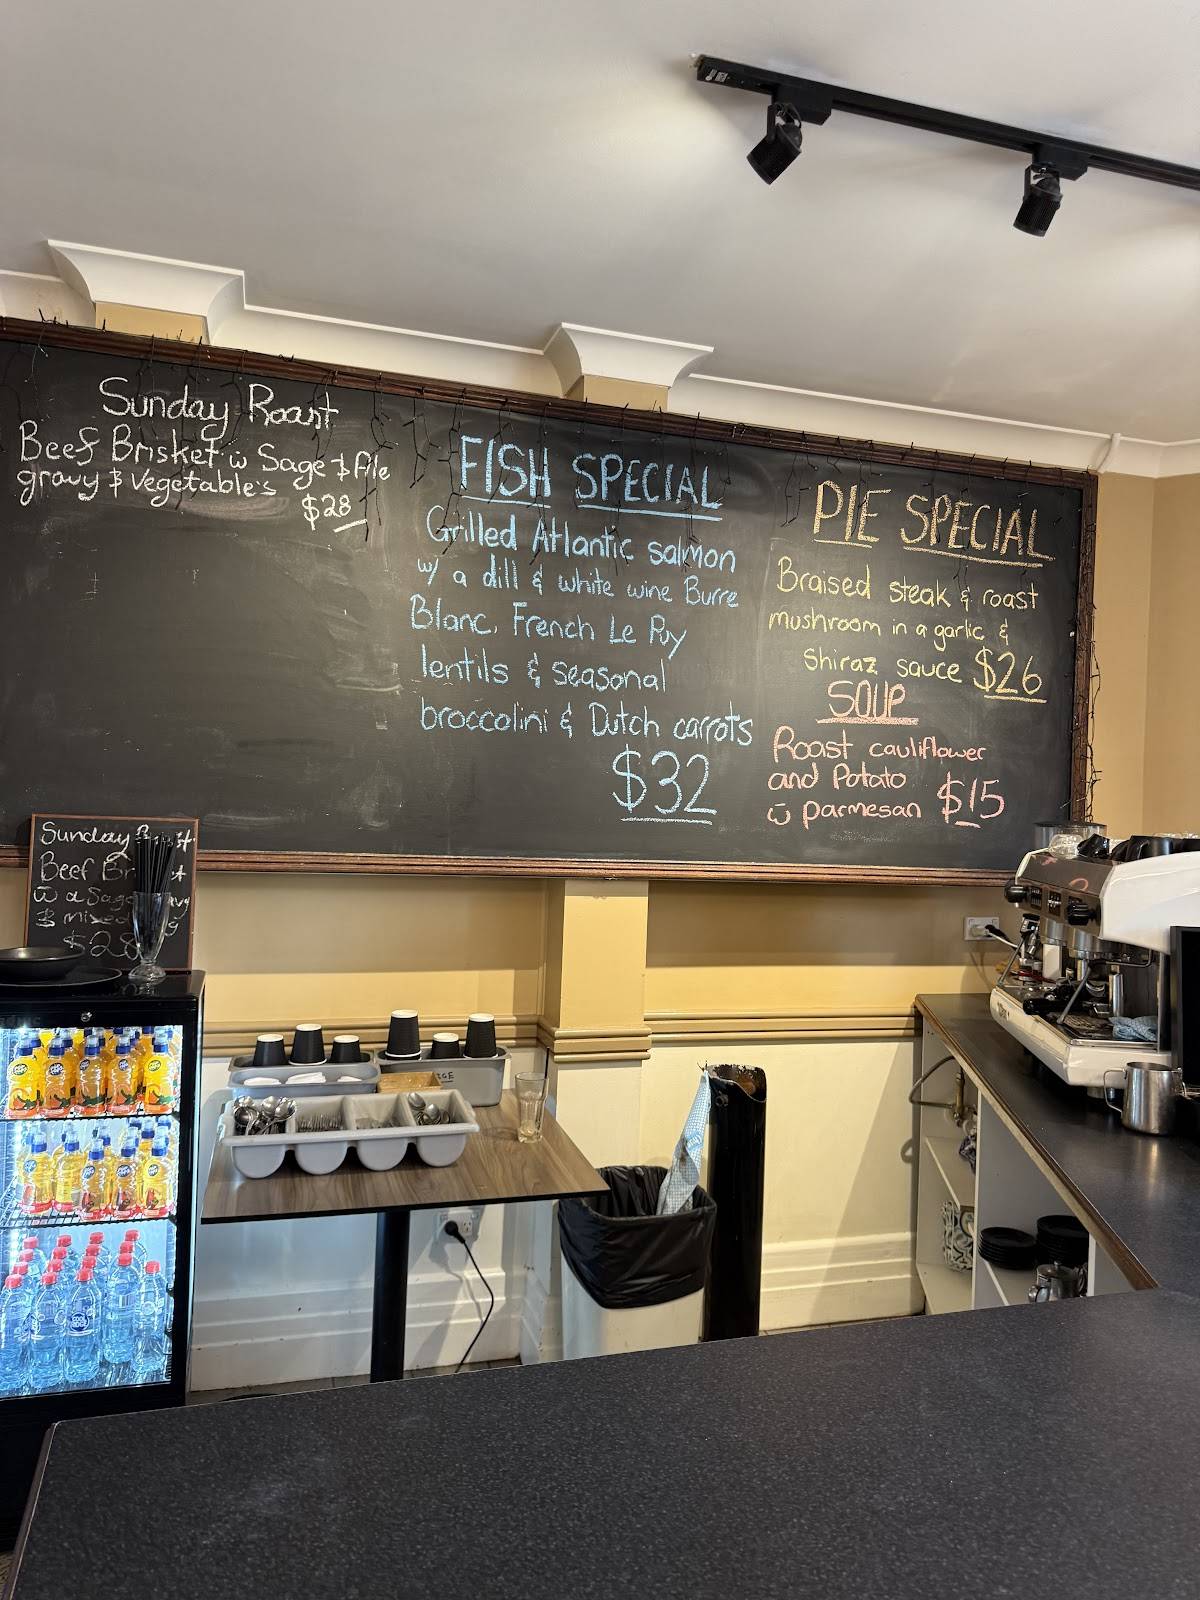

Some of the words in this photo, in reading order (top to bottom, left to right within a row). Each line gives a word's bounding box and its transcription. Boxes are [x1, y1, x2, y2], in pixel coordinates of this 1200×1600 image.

[99, 377, 228, 443] Sunday
[249, 383, 339, 430] Roast
[20, 420, 99, 466] Beef
[112, 423, 220, 469] Brisket
[257, 443, 326, 491] Sage
[460, 436, 551, 498] FISH
[572, 453, 723, 510] SPECIAL
[16, 469, 99, 506] gravy
[302, 494, 351, 530] $28
[426, 504, 516, 550] Grilled
[532, 517, 634, 560] Atlantic
[649, 536, 736, 574] salmon
[813, 480, 892, 543] PIE
[900, 494, 1056, 561] SPECIAL
[417, 557, 438, 585] w/
[453, 571, 467, 587] a
[483, 554, 518, 589] dill
[532, 564, 543, 595] &
[559, 568, 615, 597] white
[627, 579, 673, 602] wine
[683, 574, 739, 608] Burre
[777, 556, 871, 600] Braised
[889, 576, 951, 608] steak
[960, 586, 970, 612] &
[982, 583, 1038, 610] roast
[410, 592, 498, 635] Blanc,
[512, 601, 595, 641] French
[610, 613, 637, 644] Le
[650, 613, 687, 660] Puy
[768, 607, 881, 636] mushroom
[892, 618, 907, 635] in
[916, 624, 927, 639] a
[934, 619, 985, 652] garlic
[999, 618, 1009, 646] &
[422, 644, 509, 684] lentils
[528, 652, 541, 688] &
[551, 658, 666, 693] seasonal
[803, 647, 878, 675] Shiraz
[896, 658, 962, 683] sauce
[973, 645, 1043, 695] $26
[420, 696, 548, 733] broccolini
[560, 701, 572, 738] &
[588, 701, 660, 738] Dutch
[673, 701, 753, 746] carrots
[827, 679, 906, 719] SOUP
[773, 725, 853, 763] Roast
[869, 736, 986, 761] cauliflower
[612, 744, 717, 815] $32
[768, 761, 820, 791] and
[833, 762, 907, 790] Potato
[937, 771, 1005, 823] $15
[40, 821, 131, 862] Sunday
[40, 851, 94, 882] Beef
[66, 891, 84, 902] a
[63, 931, 140, 960] $28
